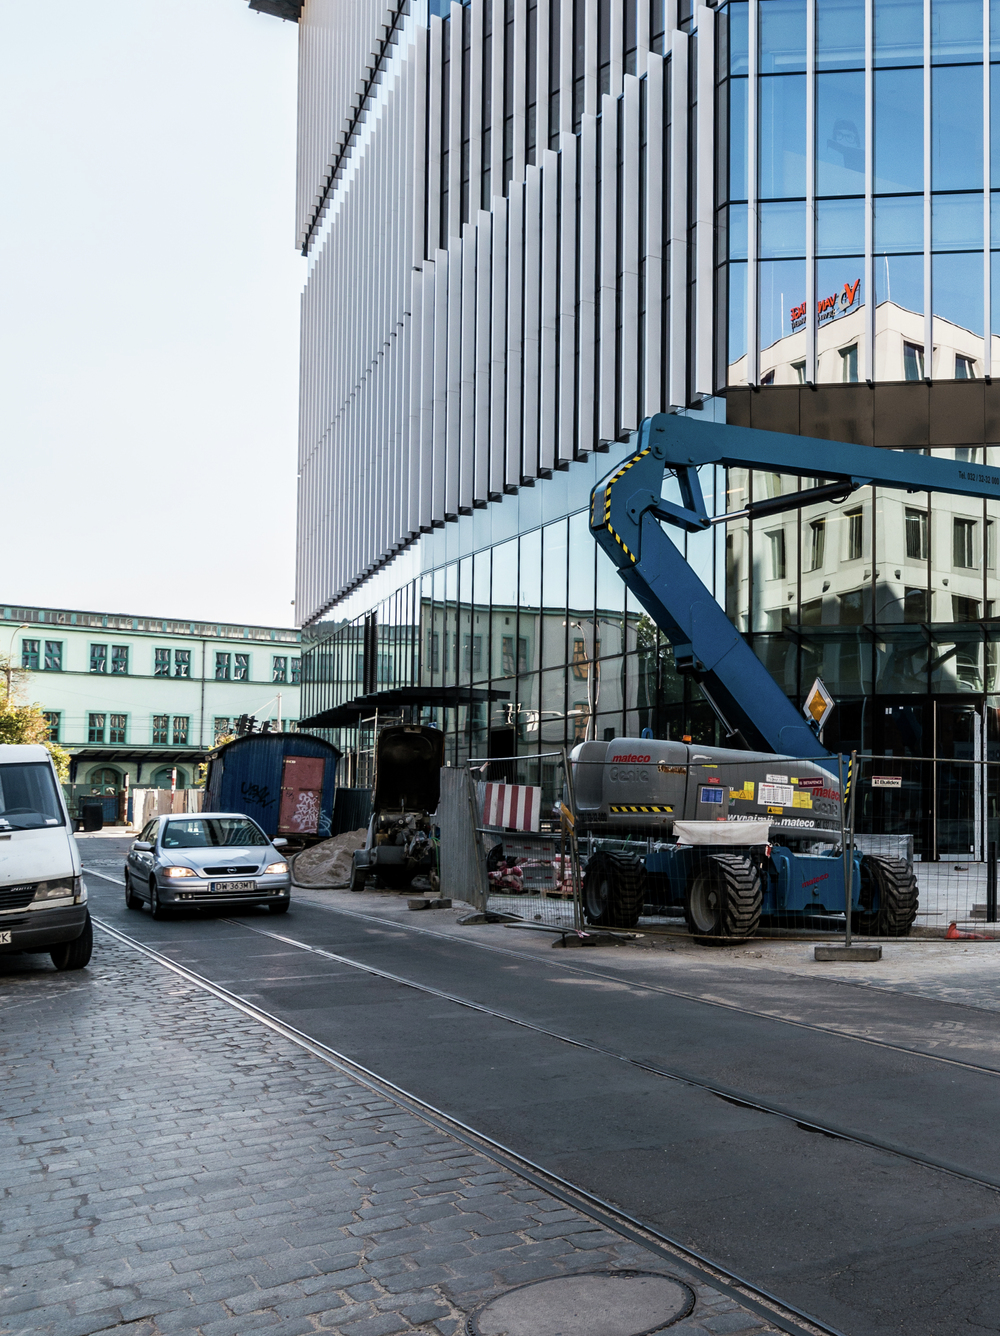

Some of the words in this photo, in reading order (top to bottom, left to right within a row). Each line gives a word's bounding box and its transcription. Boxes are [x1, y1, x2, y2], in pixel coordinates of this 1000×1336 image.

[958, 470, 967, 481] Tel.
[967, 472, 976, 482] 032
[991, 477, 1000, 486] 000
[612, 753, 651, 763] mateco
[609, 766, 649, 783] Genie
[781, 818, 815, 828] mateco
[230, 881, 253, 890] 363MT
[801, 873, 829, 889] mateco
[0, 932, 9, 943] K
